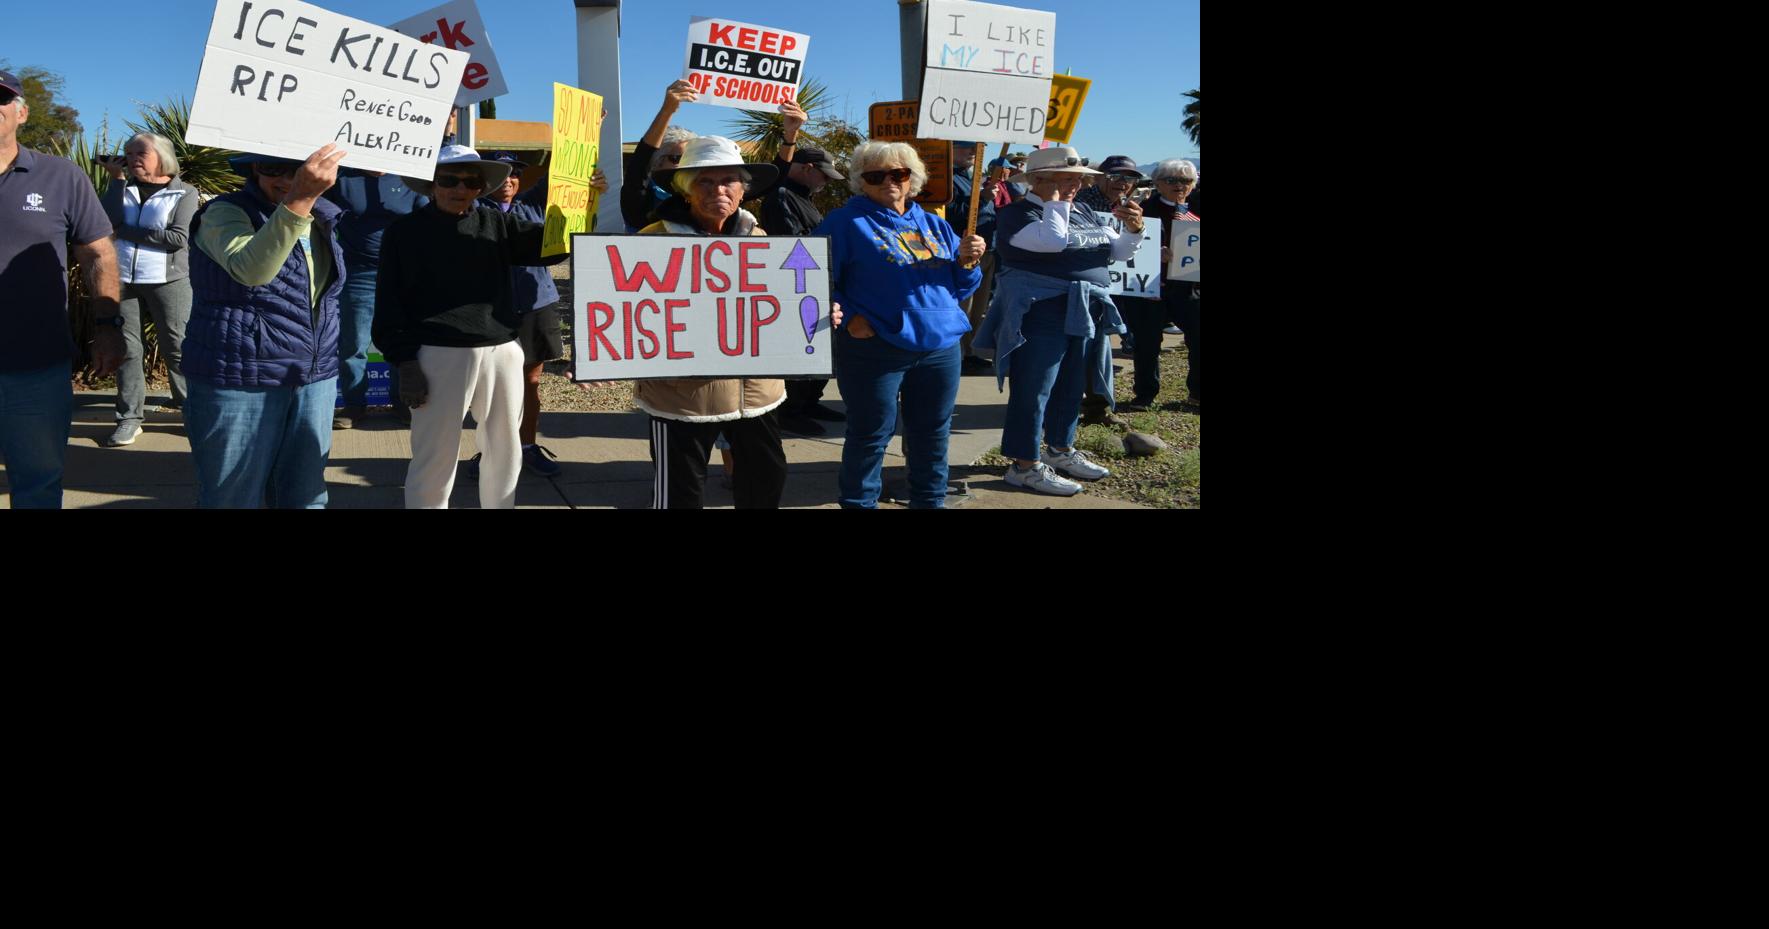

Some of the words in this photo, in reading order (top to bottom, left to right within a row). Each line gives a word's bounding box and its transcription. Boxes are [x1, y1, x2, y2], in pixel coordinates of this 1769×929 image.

[234, 1, 318, 56] ICE
[330, 27, 449, 89] KILLS
[708, 22, 797, 56] KEEP
[948, 14, 966, 37] I
[987, 22, 1046, 47] LIKE
[700, 48, 752, 74] I.C.E.
[757, 57, 796, 80] OUT
[941, 43, 979, 68] MY
[992, 49, 1045, 76] ICE
[231, 64, 298, 103] RIP
[688, 72, 713, 95] OF
[713, 76, 796, 106] SCHOOLS!
[558, 87, 573, 137] SO
[576, 95, 601, 143] MUCH
[929, 96, 1046, 135] CRUSHED
[554, 140, 599, 180] WRONG
[561, 185, 597, 213] ENOUGH
[605, 240, 771, 294] WISE
[586, 299, 695, 361] RISE
[716, 294, 781, 358] UP
